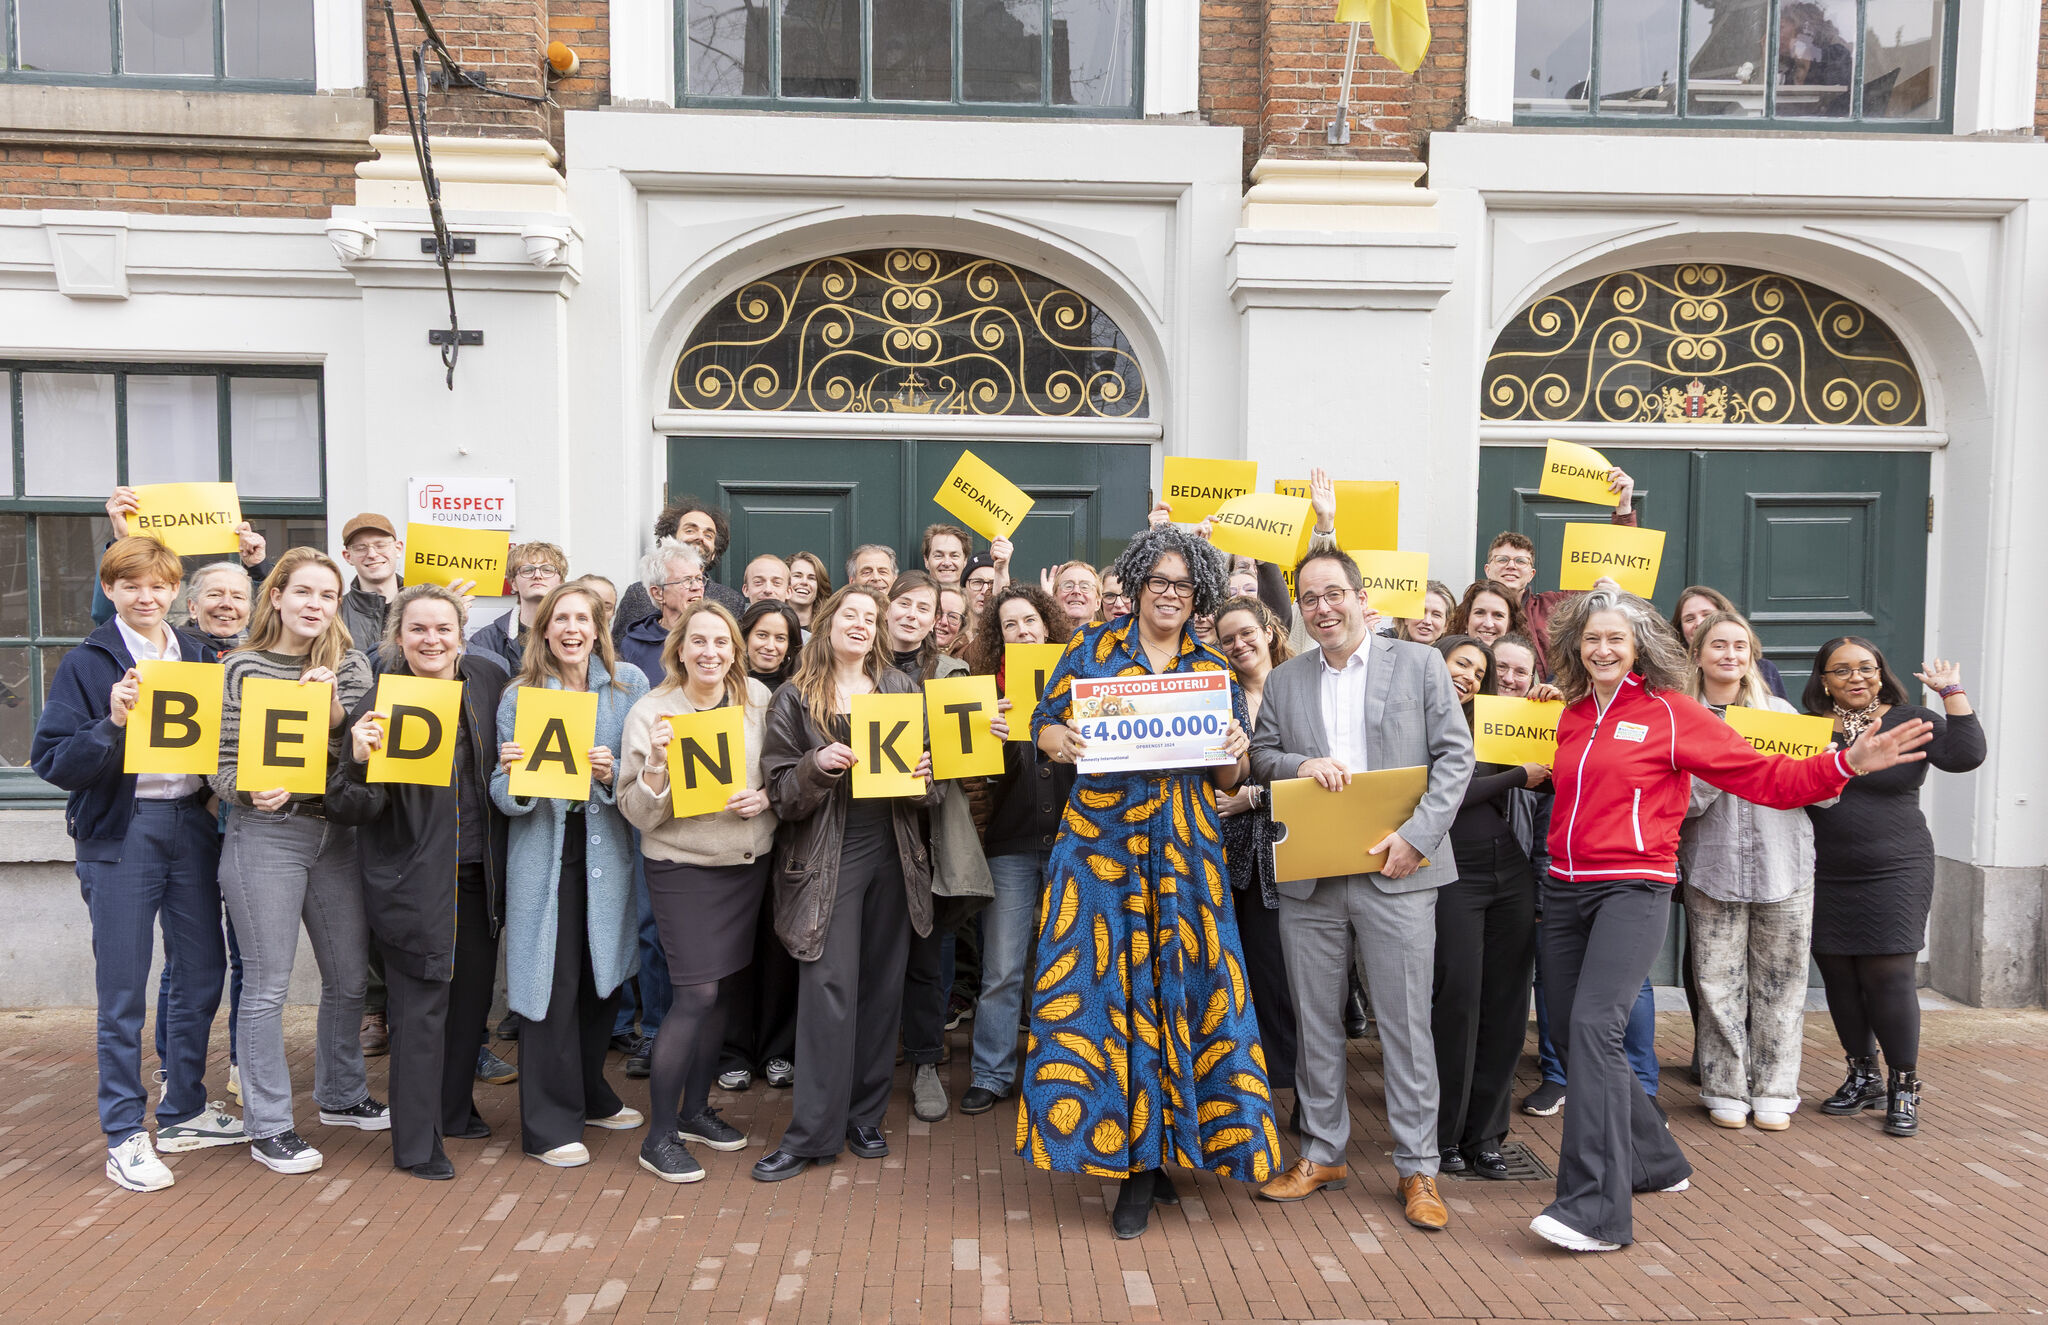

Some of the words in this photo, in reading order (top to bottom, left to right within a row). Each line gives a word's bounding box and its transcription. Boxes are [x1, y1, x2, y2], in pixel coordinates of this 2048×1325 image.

[1551, 463, 1614, 483] BEDANKT
[432, 497, 504, 510] RESPECT
[953, 477, 1013, 525] BEDANKT!
[139, 512, 232, 528] BEDANKT!
[432, 513, 502, 522] FOUNDATION
[415, 552, 497, 570] BEDANKT!
[1570, 551, 1651, 570] BEDANKT!
[1362, 577, 1418, 592] DANKT!
[1092, 681, 1158, 696] POSTCODE
[1161, 678, 1209, 691] LOTERIJ
[1484, 722, 1556, 741] BEDANKT
[1744, 736, 1818, 757] DANKT!
